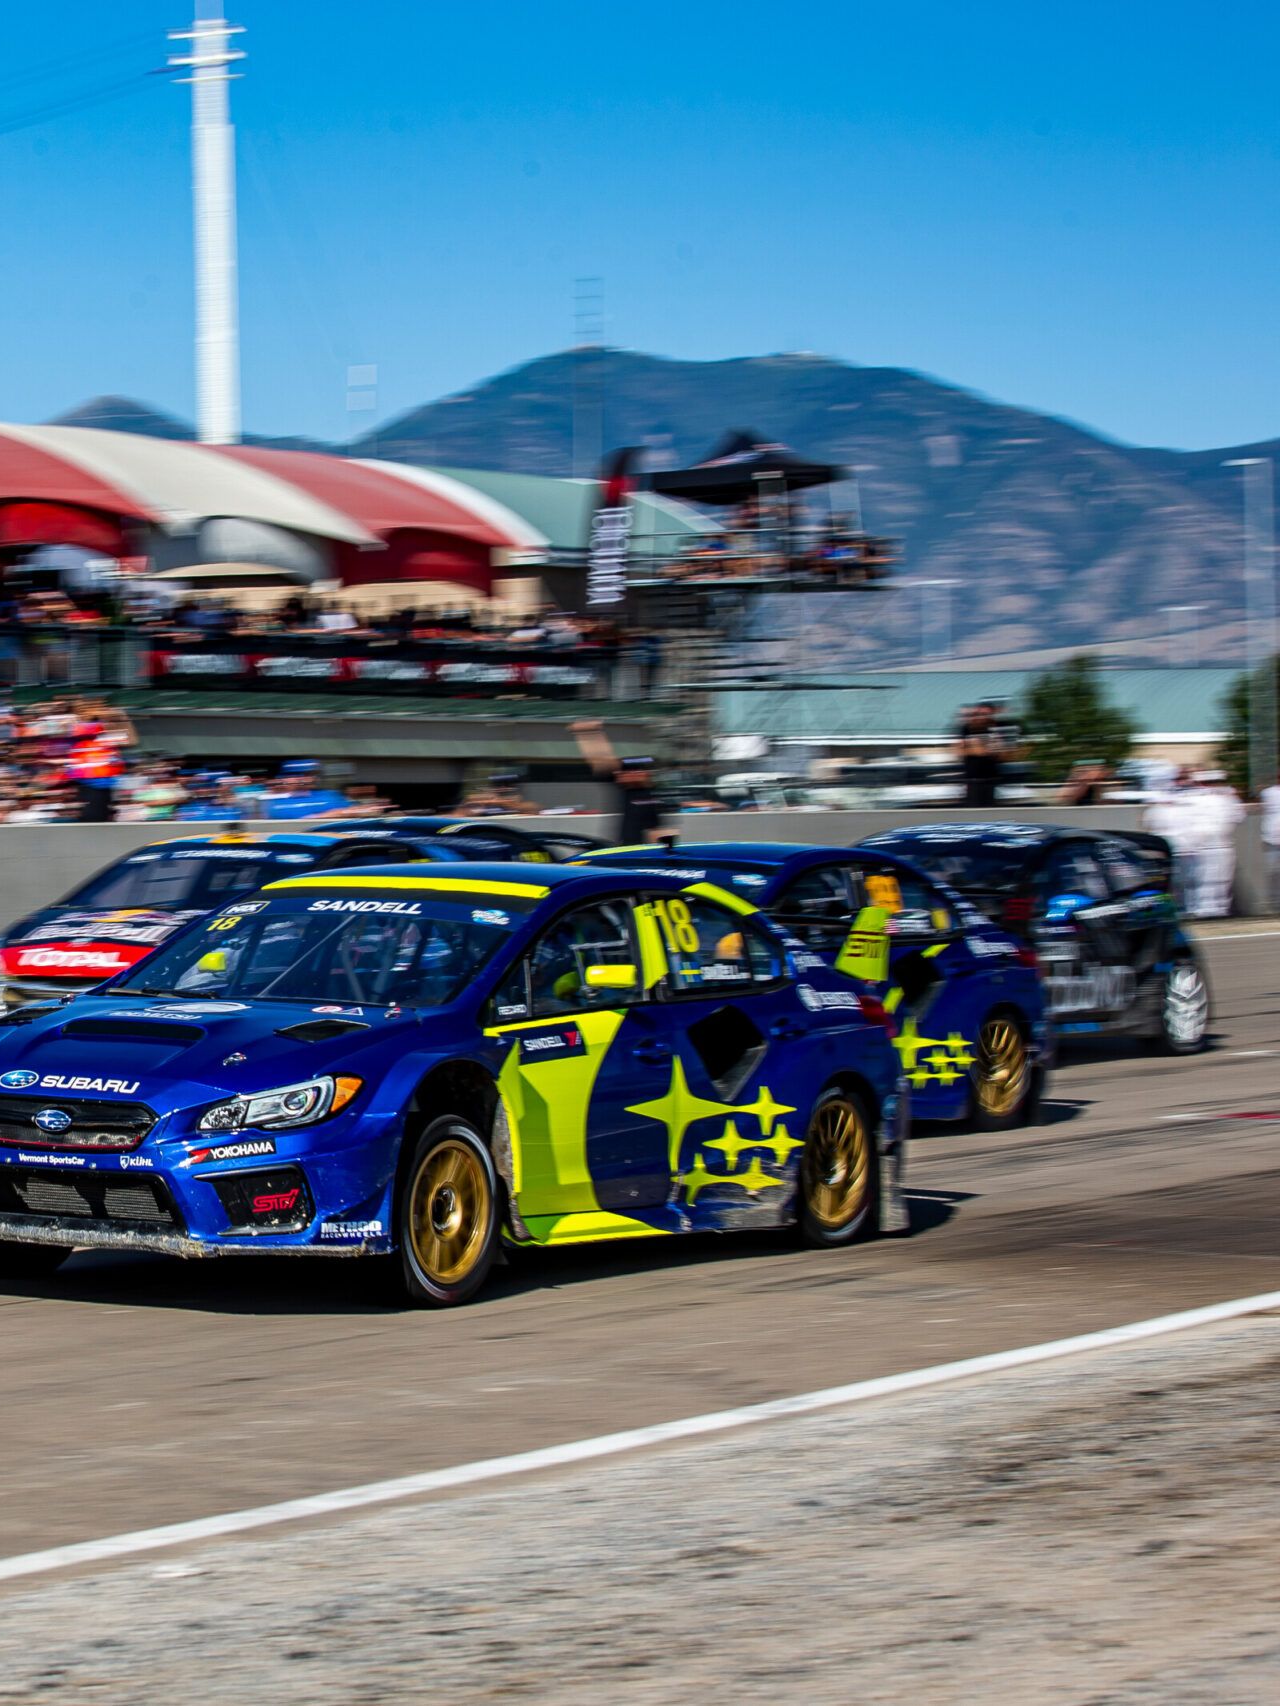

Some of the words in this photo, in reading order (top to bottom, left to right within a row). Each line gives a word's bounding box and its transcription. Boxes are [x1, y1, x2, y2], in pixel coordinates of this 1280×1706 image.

[307, 900, 422, 915] SANDELL
[206, 917, 242, 932] 18
[651, 899, 700, 953] 18
[17, 948, 132, 967] TOTAL
[40, 1075, 140, 1094] SUBARU
[210, 1141, 275, 1160] YOKOHAMA
[19, 1153, 48, 1163] Vermont
[49, 1155, 85, 1166] SportsCar
[129, 1155, 154, 1168] KÜHL
